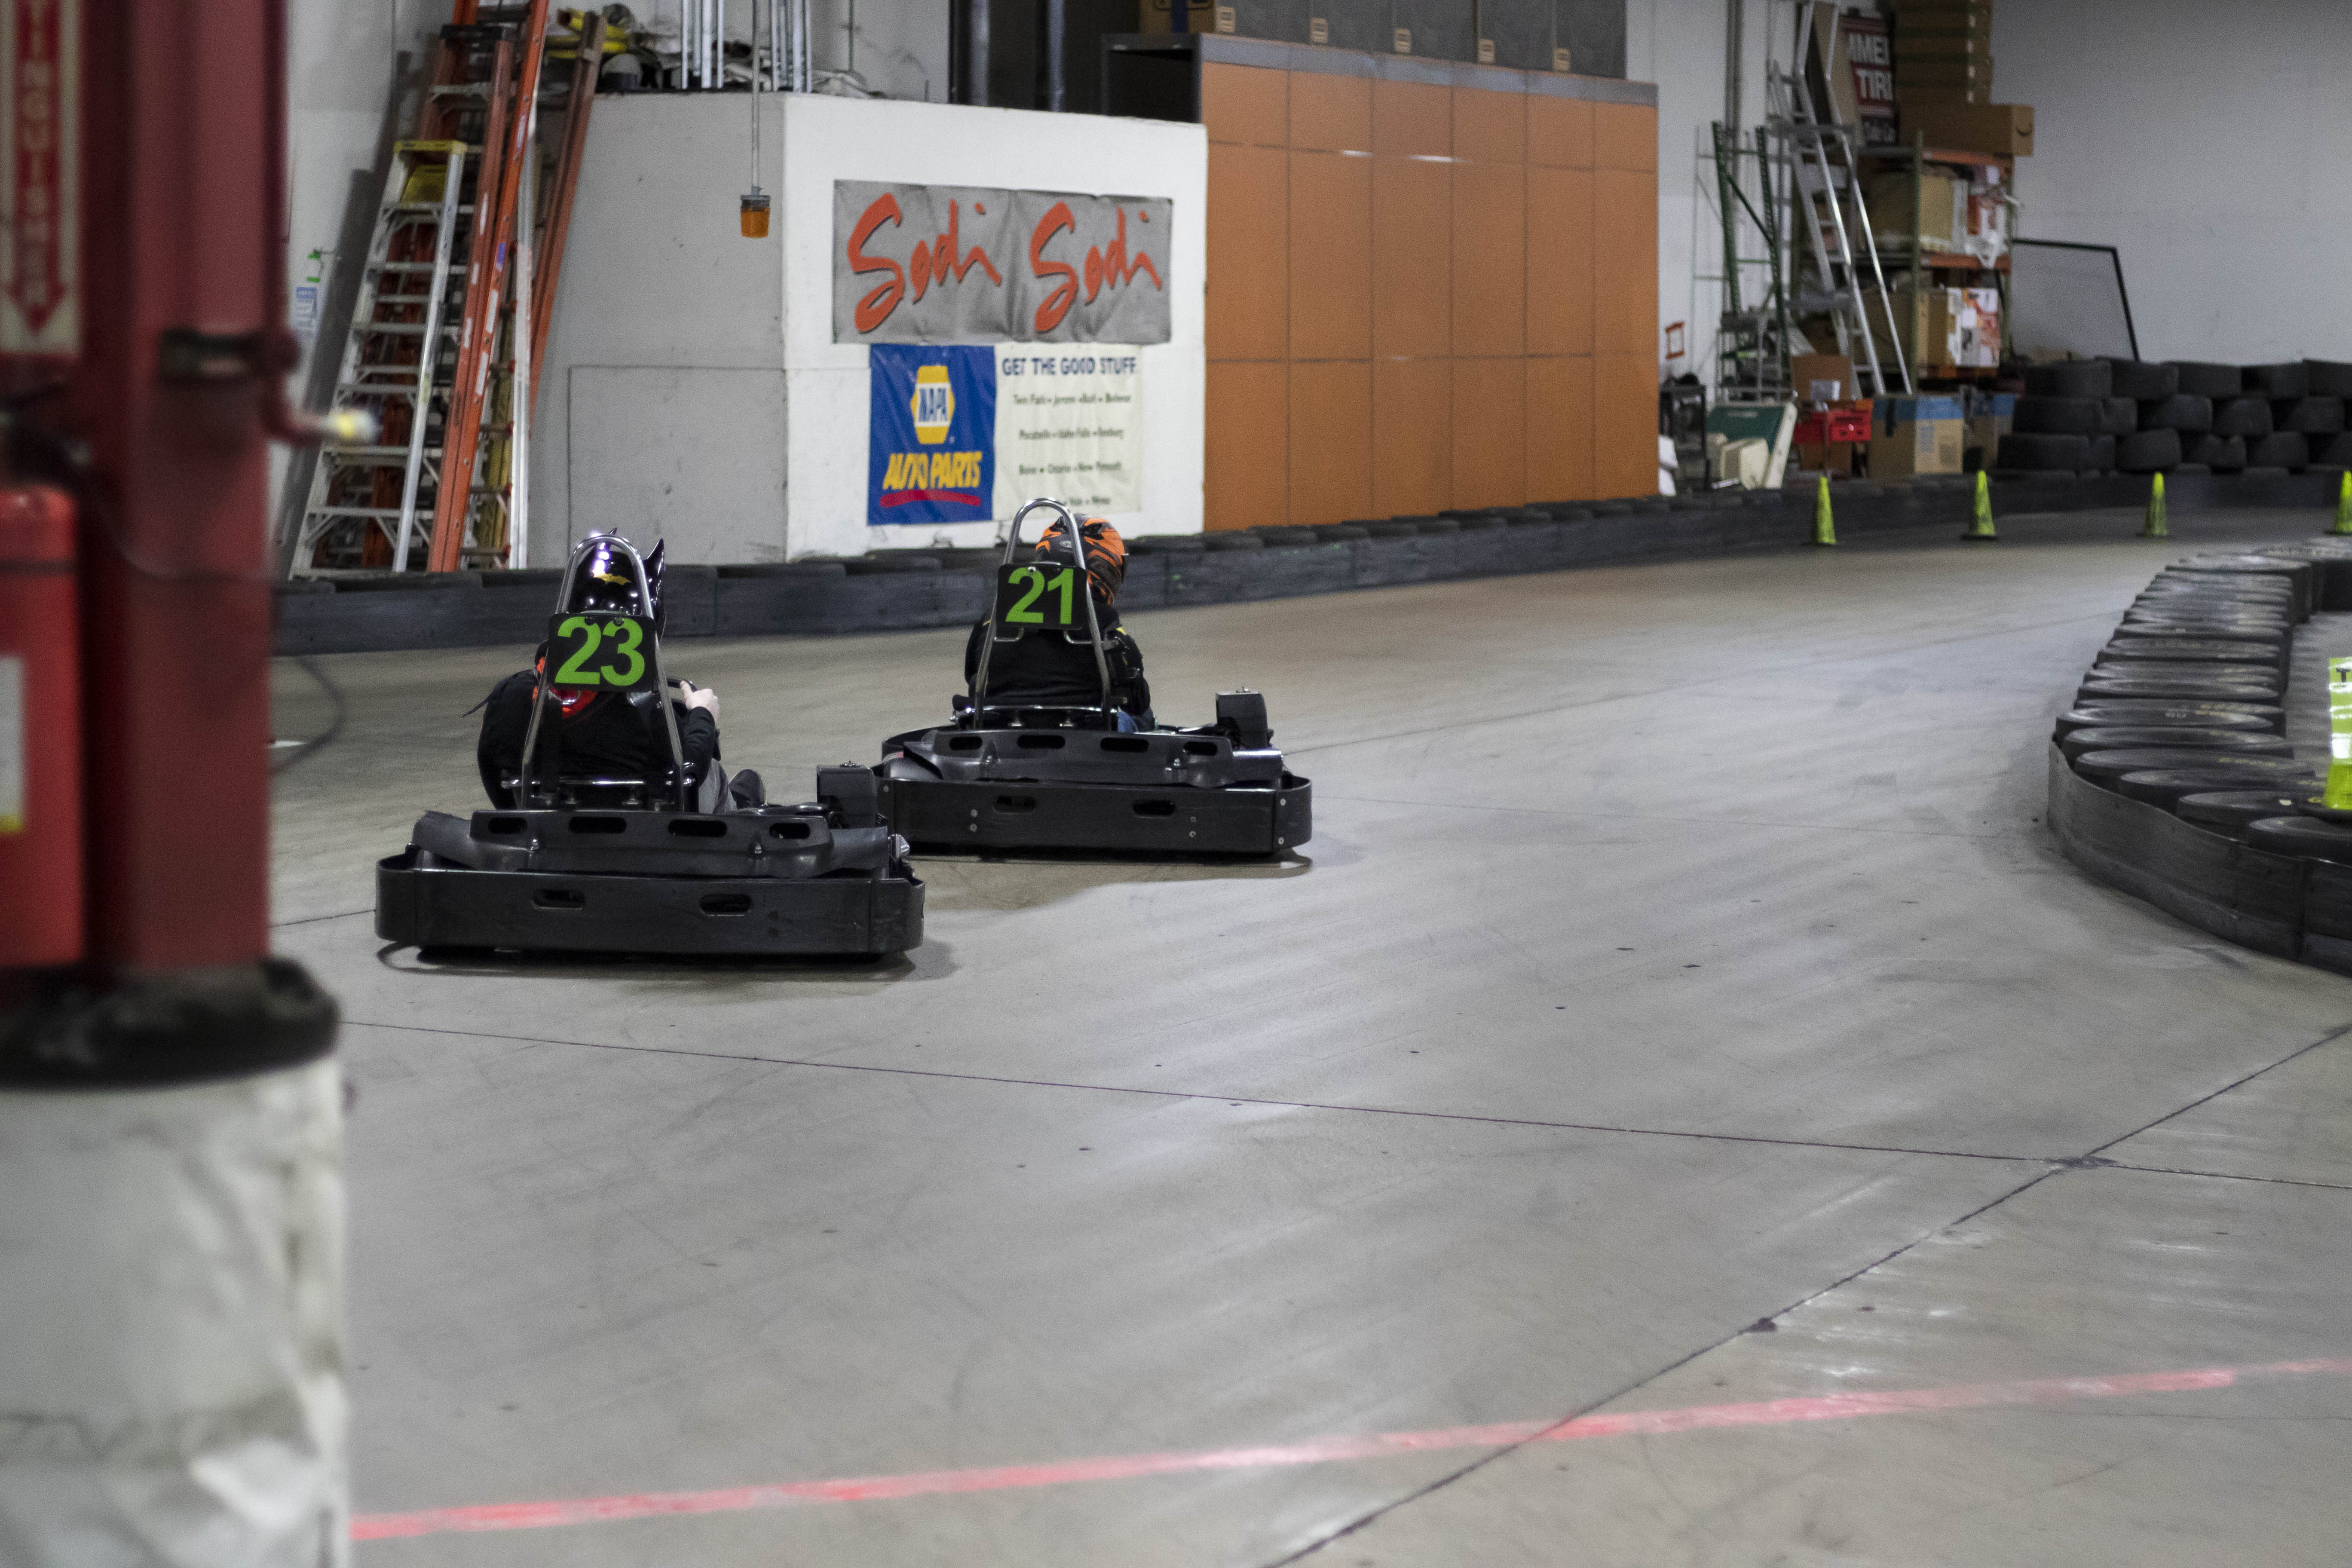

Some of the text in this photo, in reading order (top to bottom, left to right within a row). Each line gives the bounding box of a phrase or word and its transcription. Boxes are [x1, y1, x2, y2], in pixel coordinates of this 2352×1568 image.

[1002, 356, 1137, 376] GET THE GOOD STUFF
[919, 388, 948, 422] NAPA
[882, 450, 983, 490] AUTO PARTS
[1005, 567, 1074, 625] 21
[554, 616, 645, 686] 23
